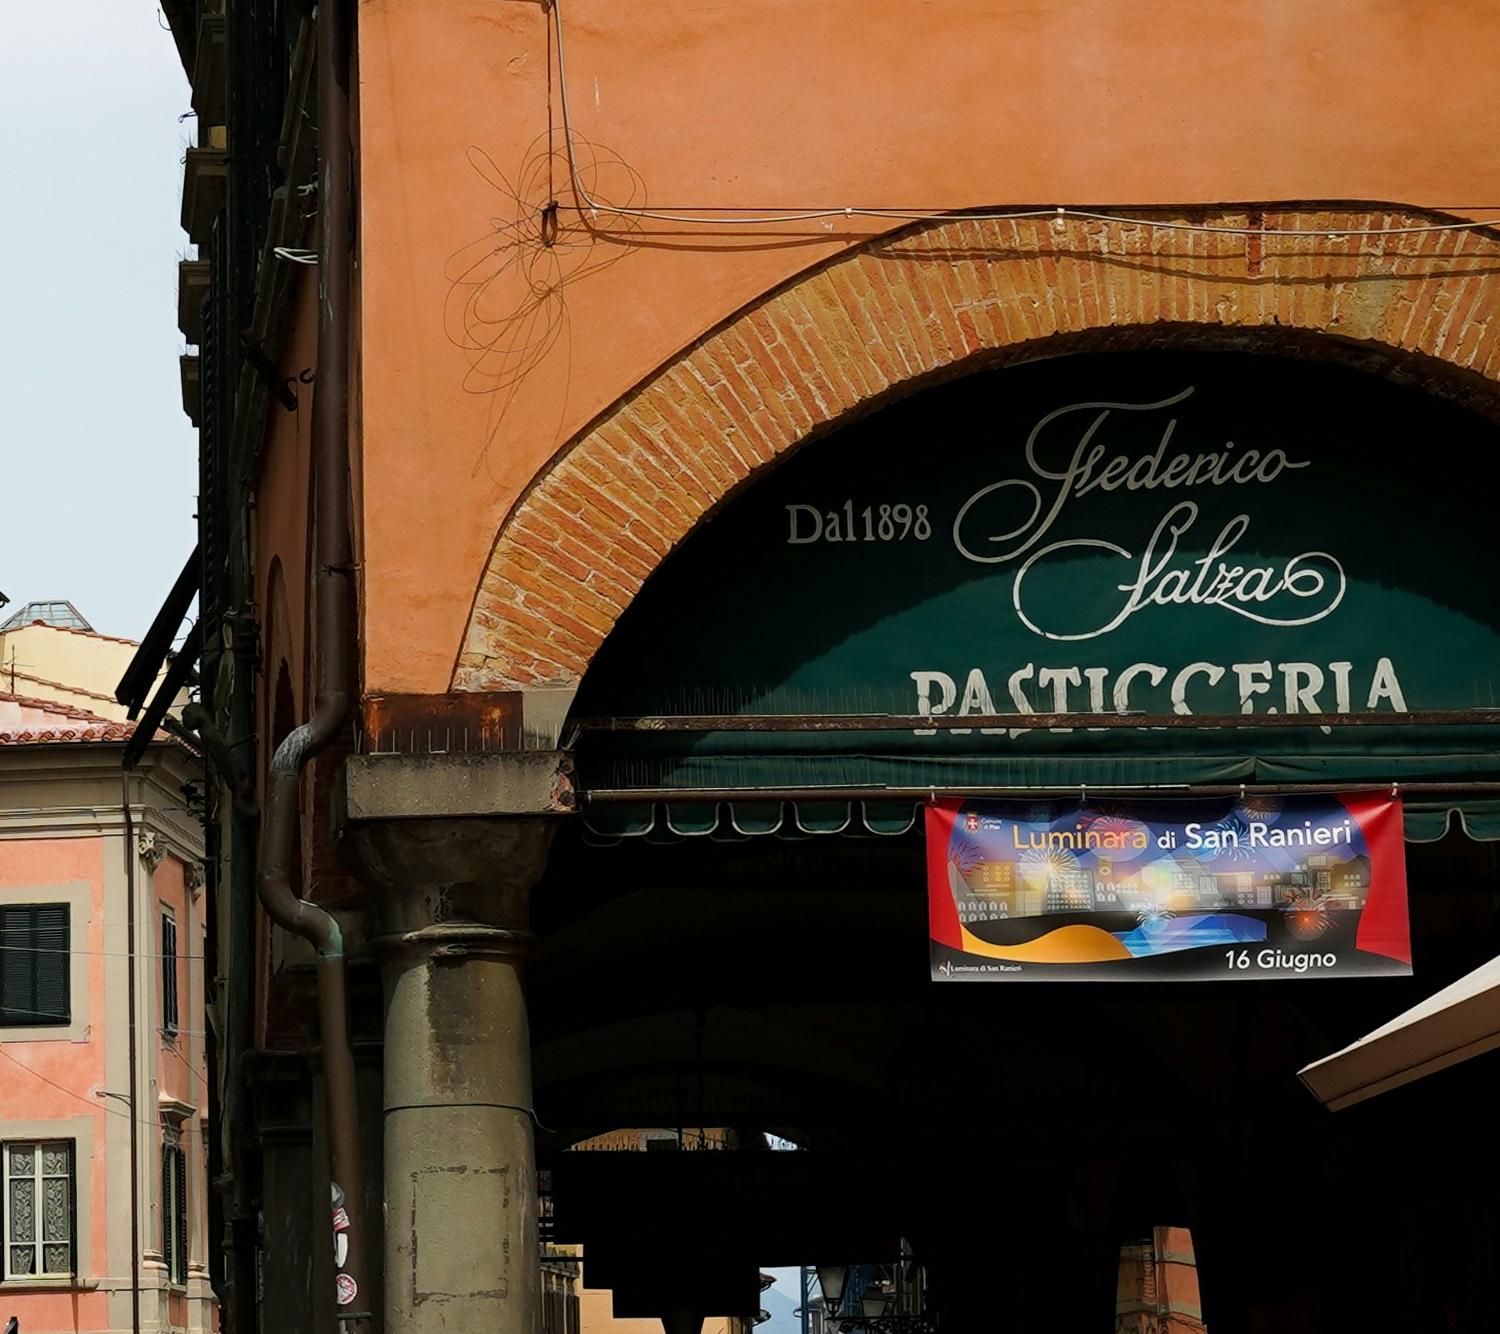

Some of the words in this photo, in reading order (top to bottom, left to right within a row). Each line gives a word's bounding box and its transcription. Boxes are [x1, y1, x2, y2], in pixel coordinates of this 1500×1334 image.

[953, 386, 1311, 564] Federico
[785, 500, 858, 545] Dal
[861, 502, 932, 542] 1898
[1012, 500, 1346, 642] Salza
[910, 656, 1409, 737] PASTICCERIA
[1011, 824, 1148, 851] Luminara
[1157, 830, 1176, 850] di
[1185, 822, 1238, 849] San
[1249, 819, 1352, 847] Ranieri
[1225, 950, 1250, 970] 16
[1256, 949, 1337, 973] Giugno
